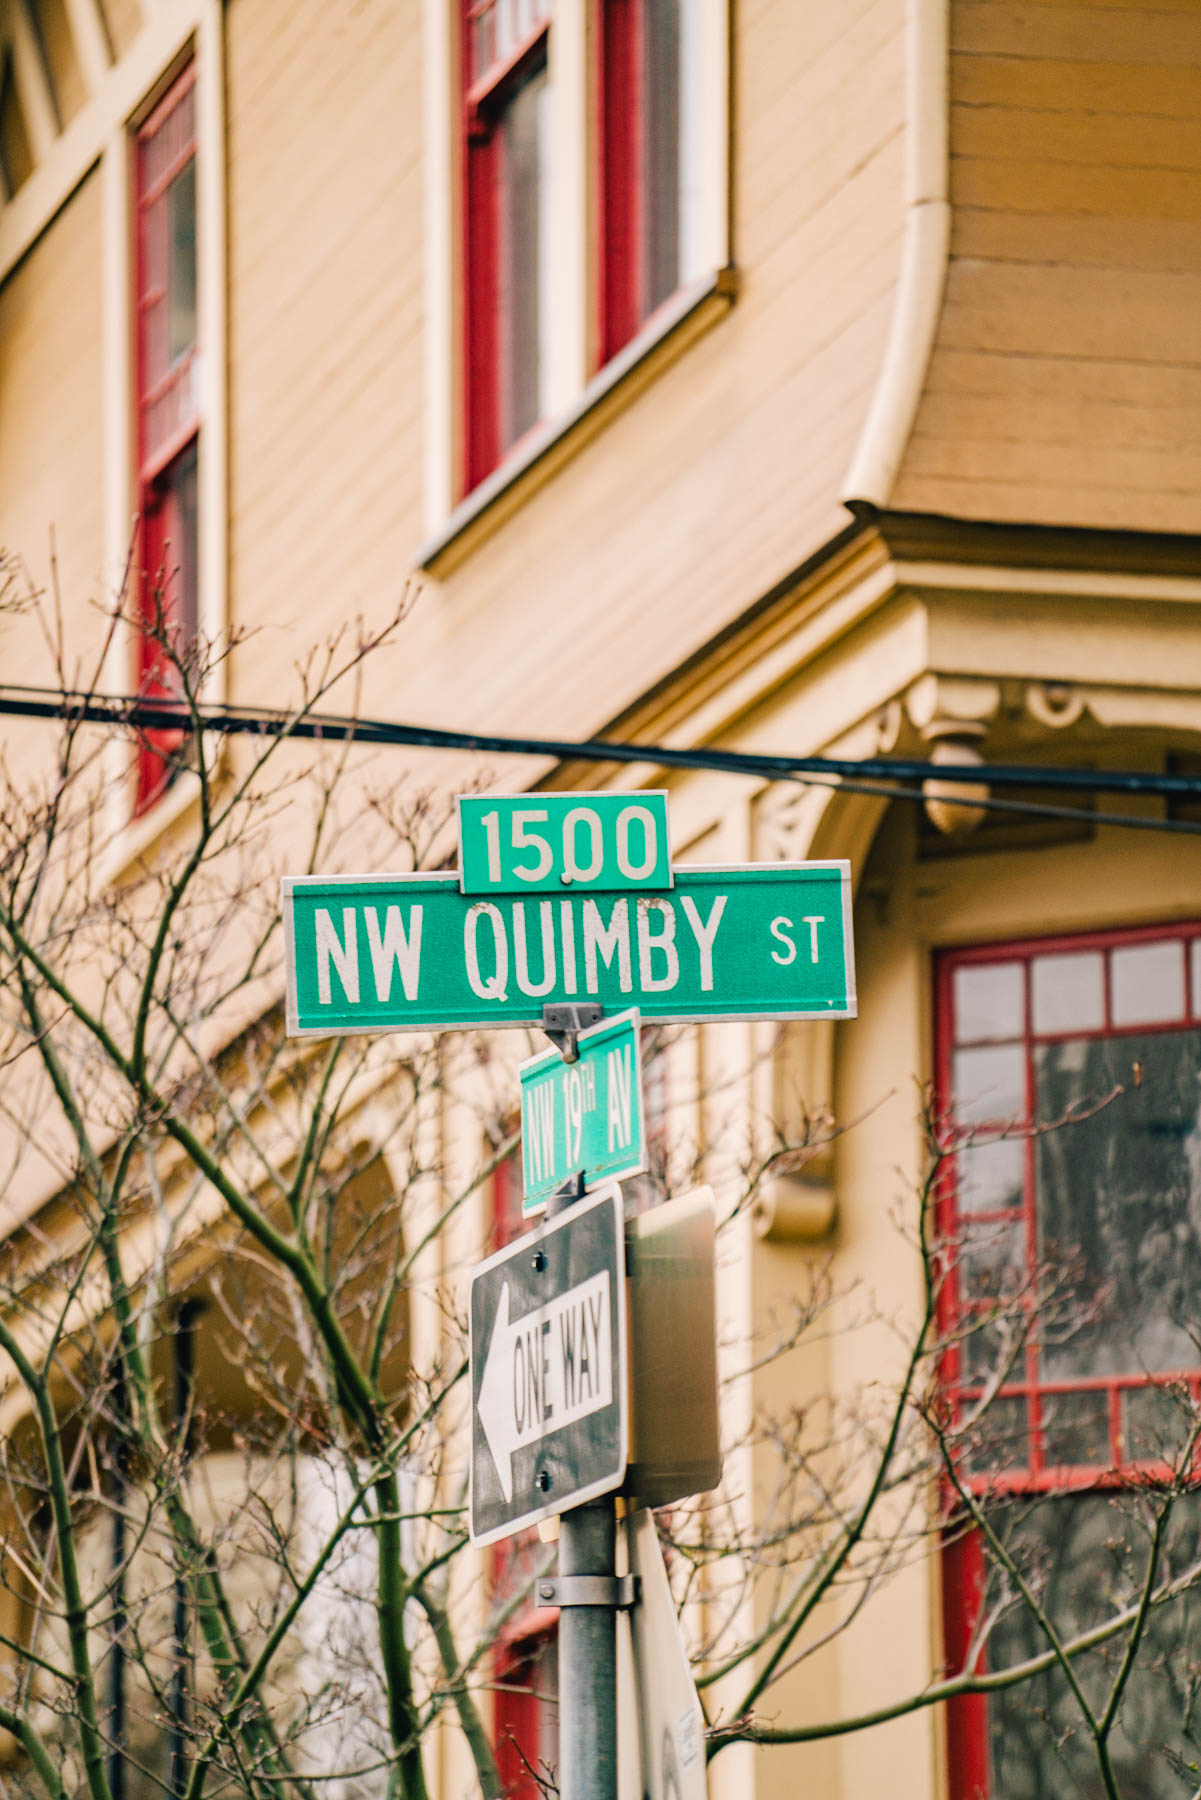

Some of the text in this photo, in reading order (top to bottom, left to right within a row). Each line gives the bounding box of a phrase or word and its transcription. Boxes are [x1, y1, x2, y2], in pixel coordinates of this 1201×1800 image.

[480, 805, 658, 883] 1500
[314, 896, 826, 1005] NW QUIMBY ST
[527, 1043, 632, 1187] NW 19TH AV
[513, 1290, 603, 1436] ONE WAY
